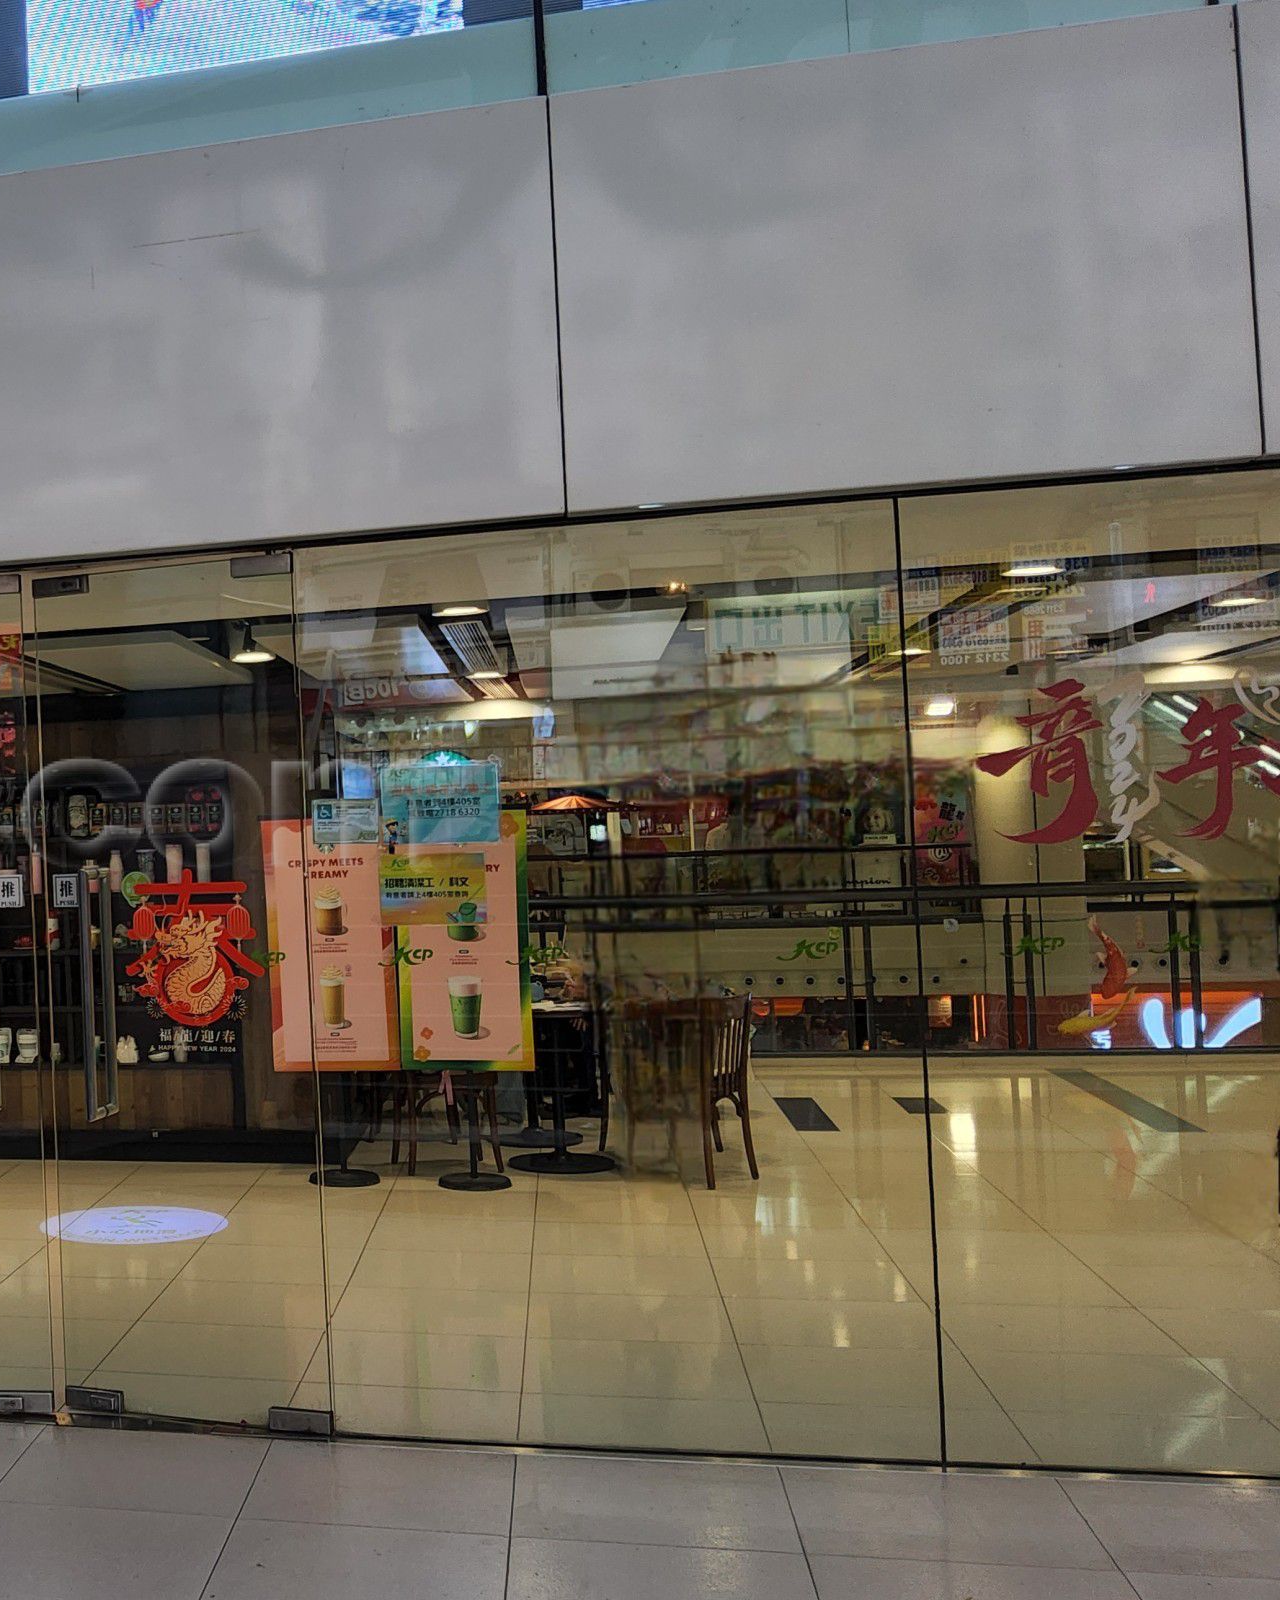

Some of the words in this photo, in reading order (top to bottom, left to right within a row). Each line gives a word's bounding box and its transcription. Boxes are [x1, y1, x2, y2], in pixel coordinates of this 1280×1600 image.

[459, 807, 480, 816] 6320
[288, 858, 327, 868] CRSPY
[329, 857, 364, 867] MEETS
[304, 869, 349, 879] REAMY
[1, 881, 16, 898] 推
[60, 880, 74, 897] 推
